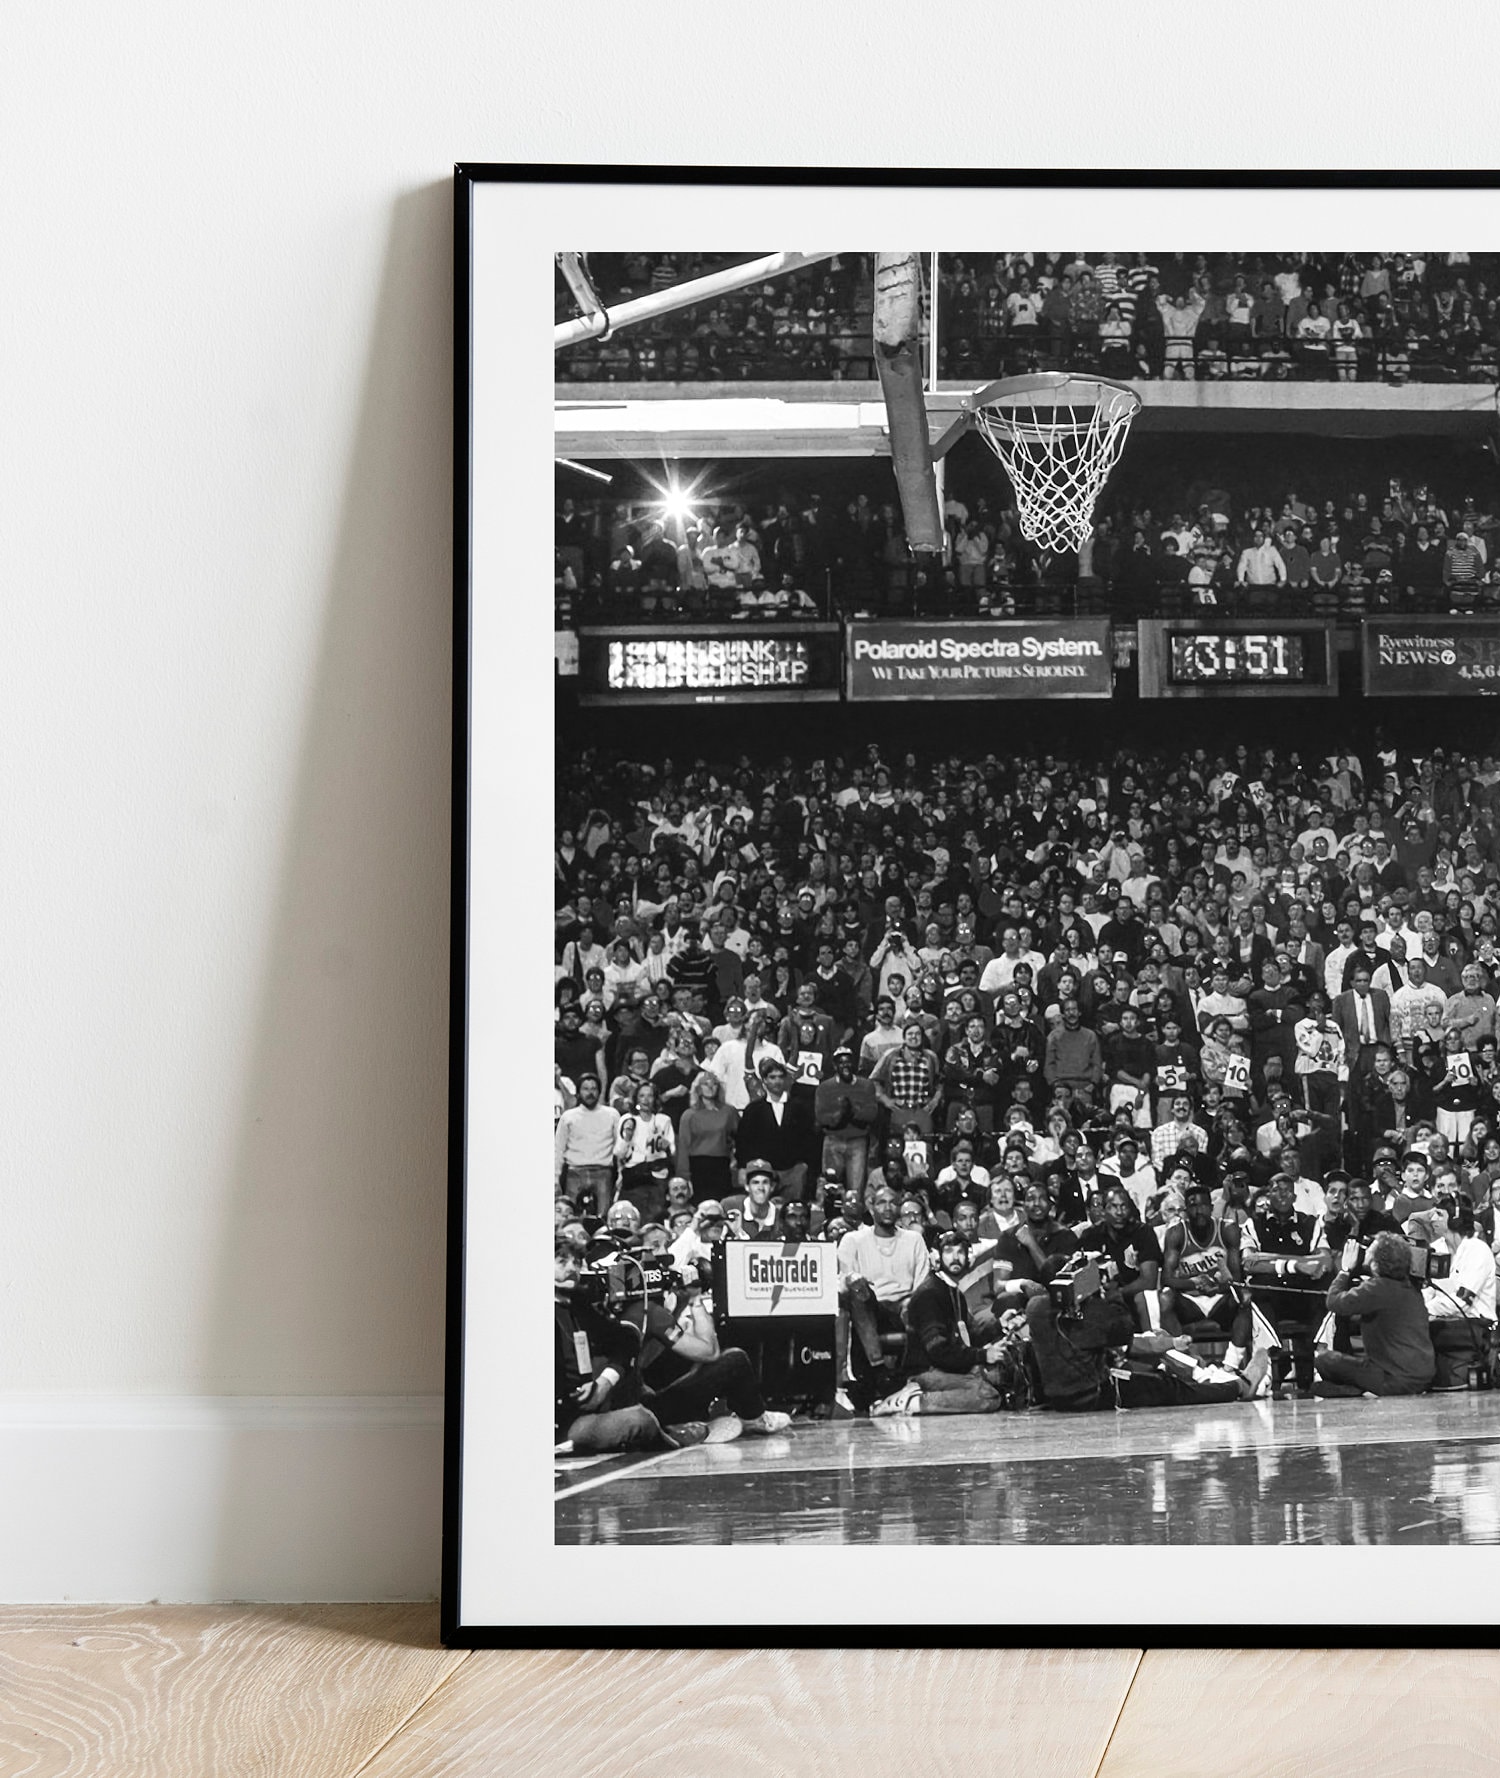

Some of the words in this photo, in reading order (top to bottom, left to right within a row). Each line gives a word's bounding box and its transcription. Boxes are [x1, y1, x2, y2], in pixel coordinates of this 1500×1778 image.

[854, 640, 938, 660] Polaroid
[939, 638, 1020, 662] Spectra
[1021, 637, 1103, 661] System.
[1378, 634, 1455, 652] Eyewitness
[1379, 650, 1441, 665] NEWS
[1229, 1065, 1248, 1083] 10
[749, 1252, 818, 1284] Gatorade
